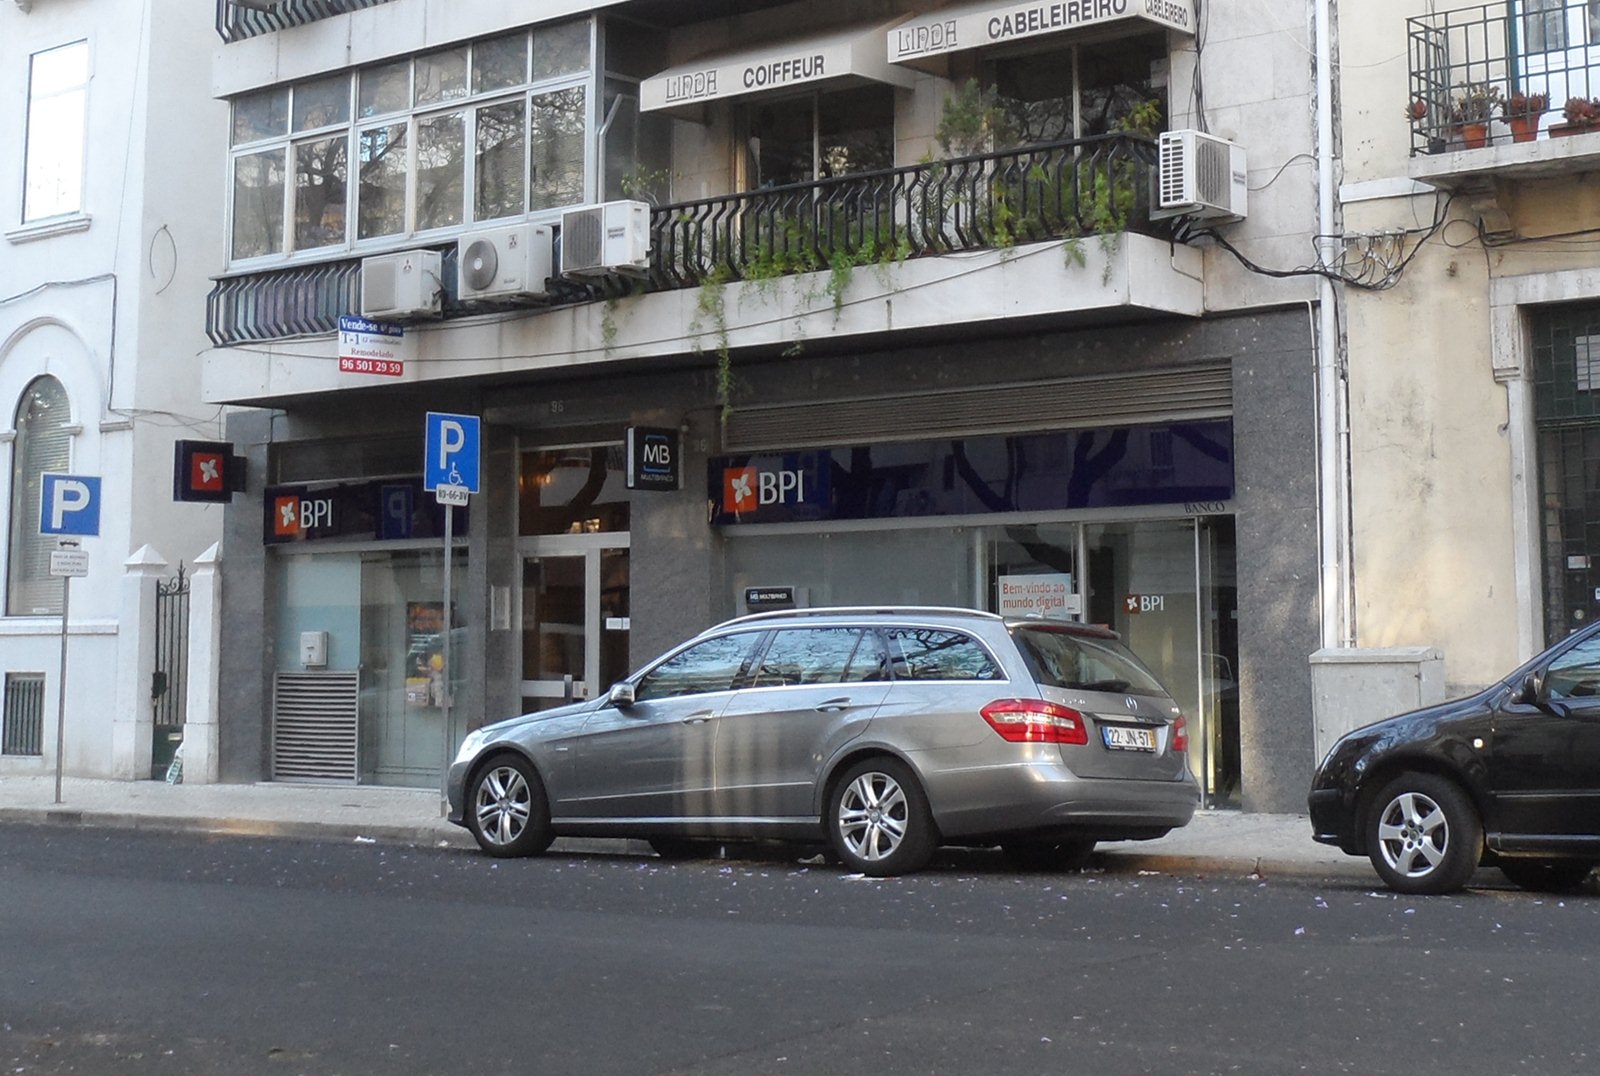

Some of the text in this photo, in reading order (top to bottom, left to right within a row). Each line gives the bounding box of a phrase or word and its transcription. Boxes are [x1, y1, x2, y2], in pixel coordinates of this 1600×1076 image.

[988, 0, 1127, 39] CABELEIREIRO
[743, 55, 825, 88] COIFFEUR
[341, 318, 378, 331] Vende-se
[342, 332, 360, 345] T-1
[351, 347, 394, 358] Remodelado
[341, 359, 401, 374] 96 501 29 59
[440, 420, 465, 470] P
[643, 443, 670, 464] MB
[759, 469, 804, 505] BPI
[52, 479, 90, 529] P
[1184, 501, 1225, 513] BANCO
[301, 499, 332, 528] BPI
[1003, 583, 1065, 594] Bem-vindo ao
[1003, 594, 1065, 609] mundo digital
[1141, 596, 1164, 611] BPI
